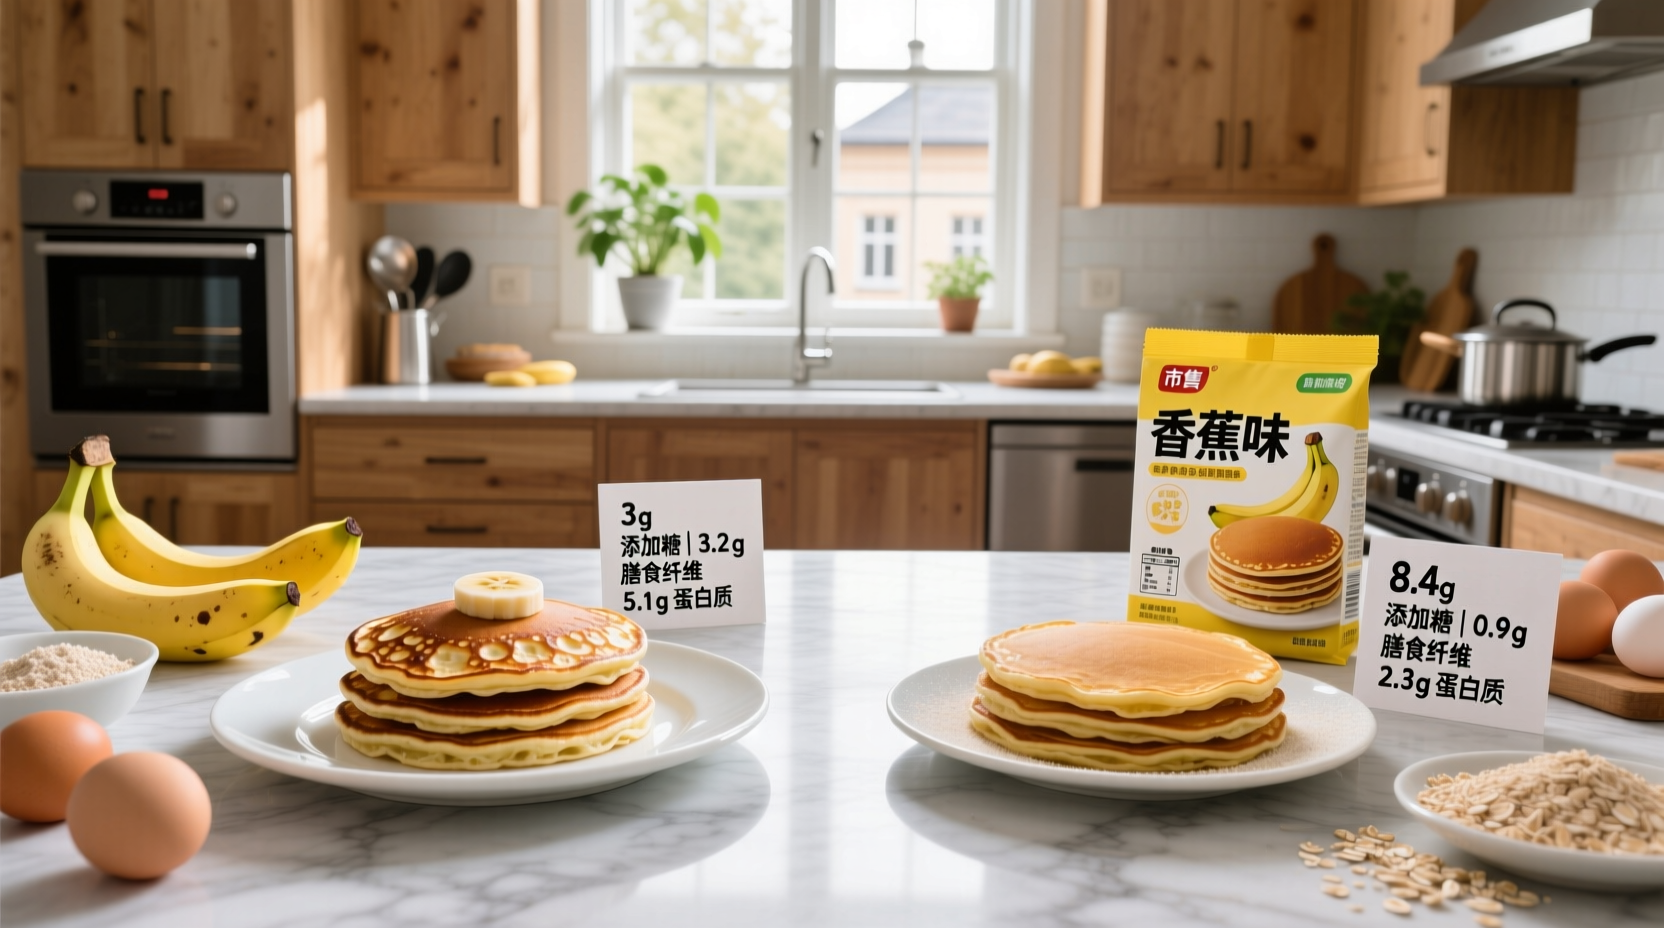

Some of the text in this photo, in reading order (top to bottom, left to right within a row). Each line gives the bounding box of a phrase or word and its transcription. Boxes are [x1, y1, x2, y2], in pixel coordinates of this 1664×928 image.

[1151, 408, 1290, 463] 香蕉味
[621, 502, 652, 531] 3g
[620, 534, 681, 557] 添加糖
[698, 533, 745, 557] 3.2g
[620, 560, 703, 585] 膳食纤维
[1389, 560, 1455, 604] 8.4g
[623, 585, 733, 615] 5.1g 蛋白质
[1384, 602, 1454, 634] 添加糖
[1473, 614, 1528, 649] 0.9g
[1380, 633, 1472, 668] 膳食纤维
[1378, 665, 1505, 706] 2.3g 蛋白质
